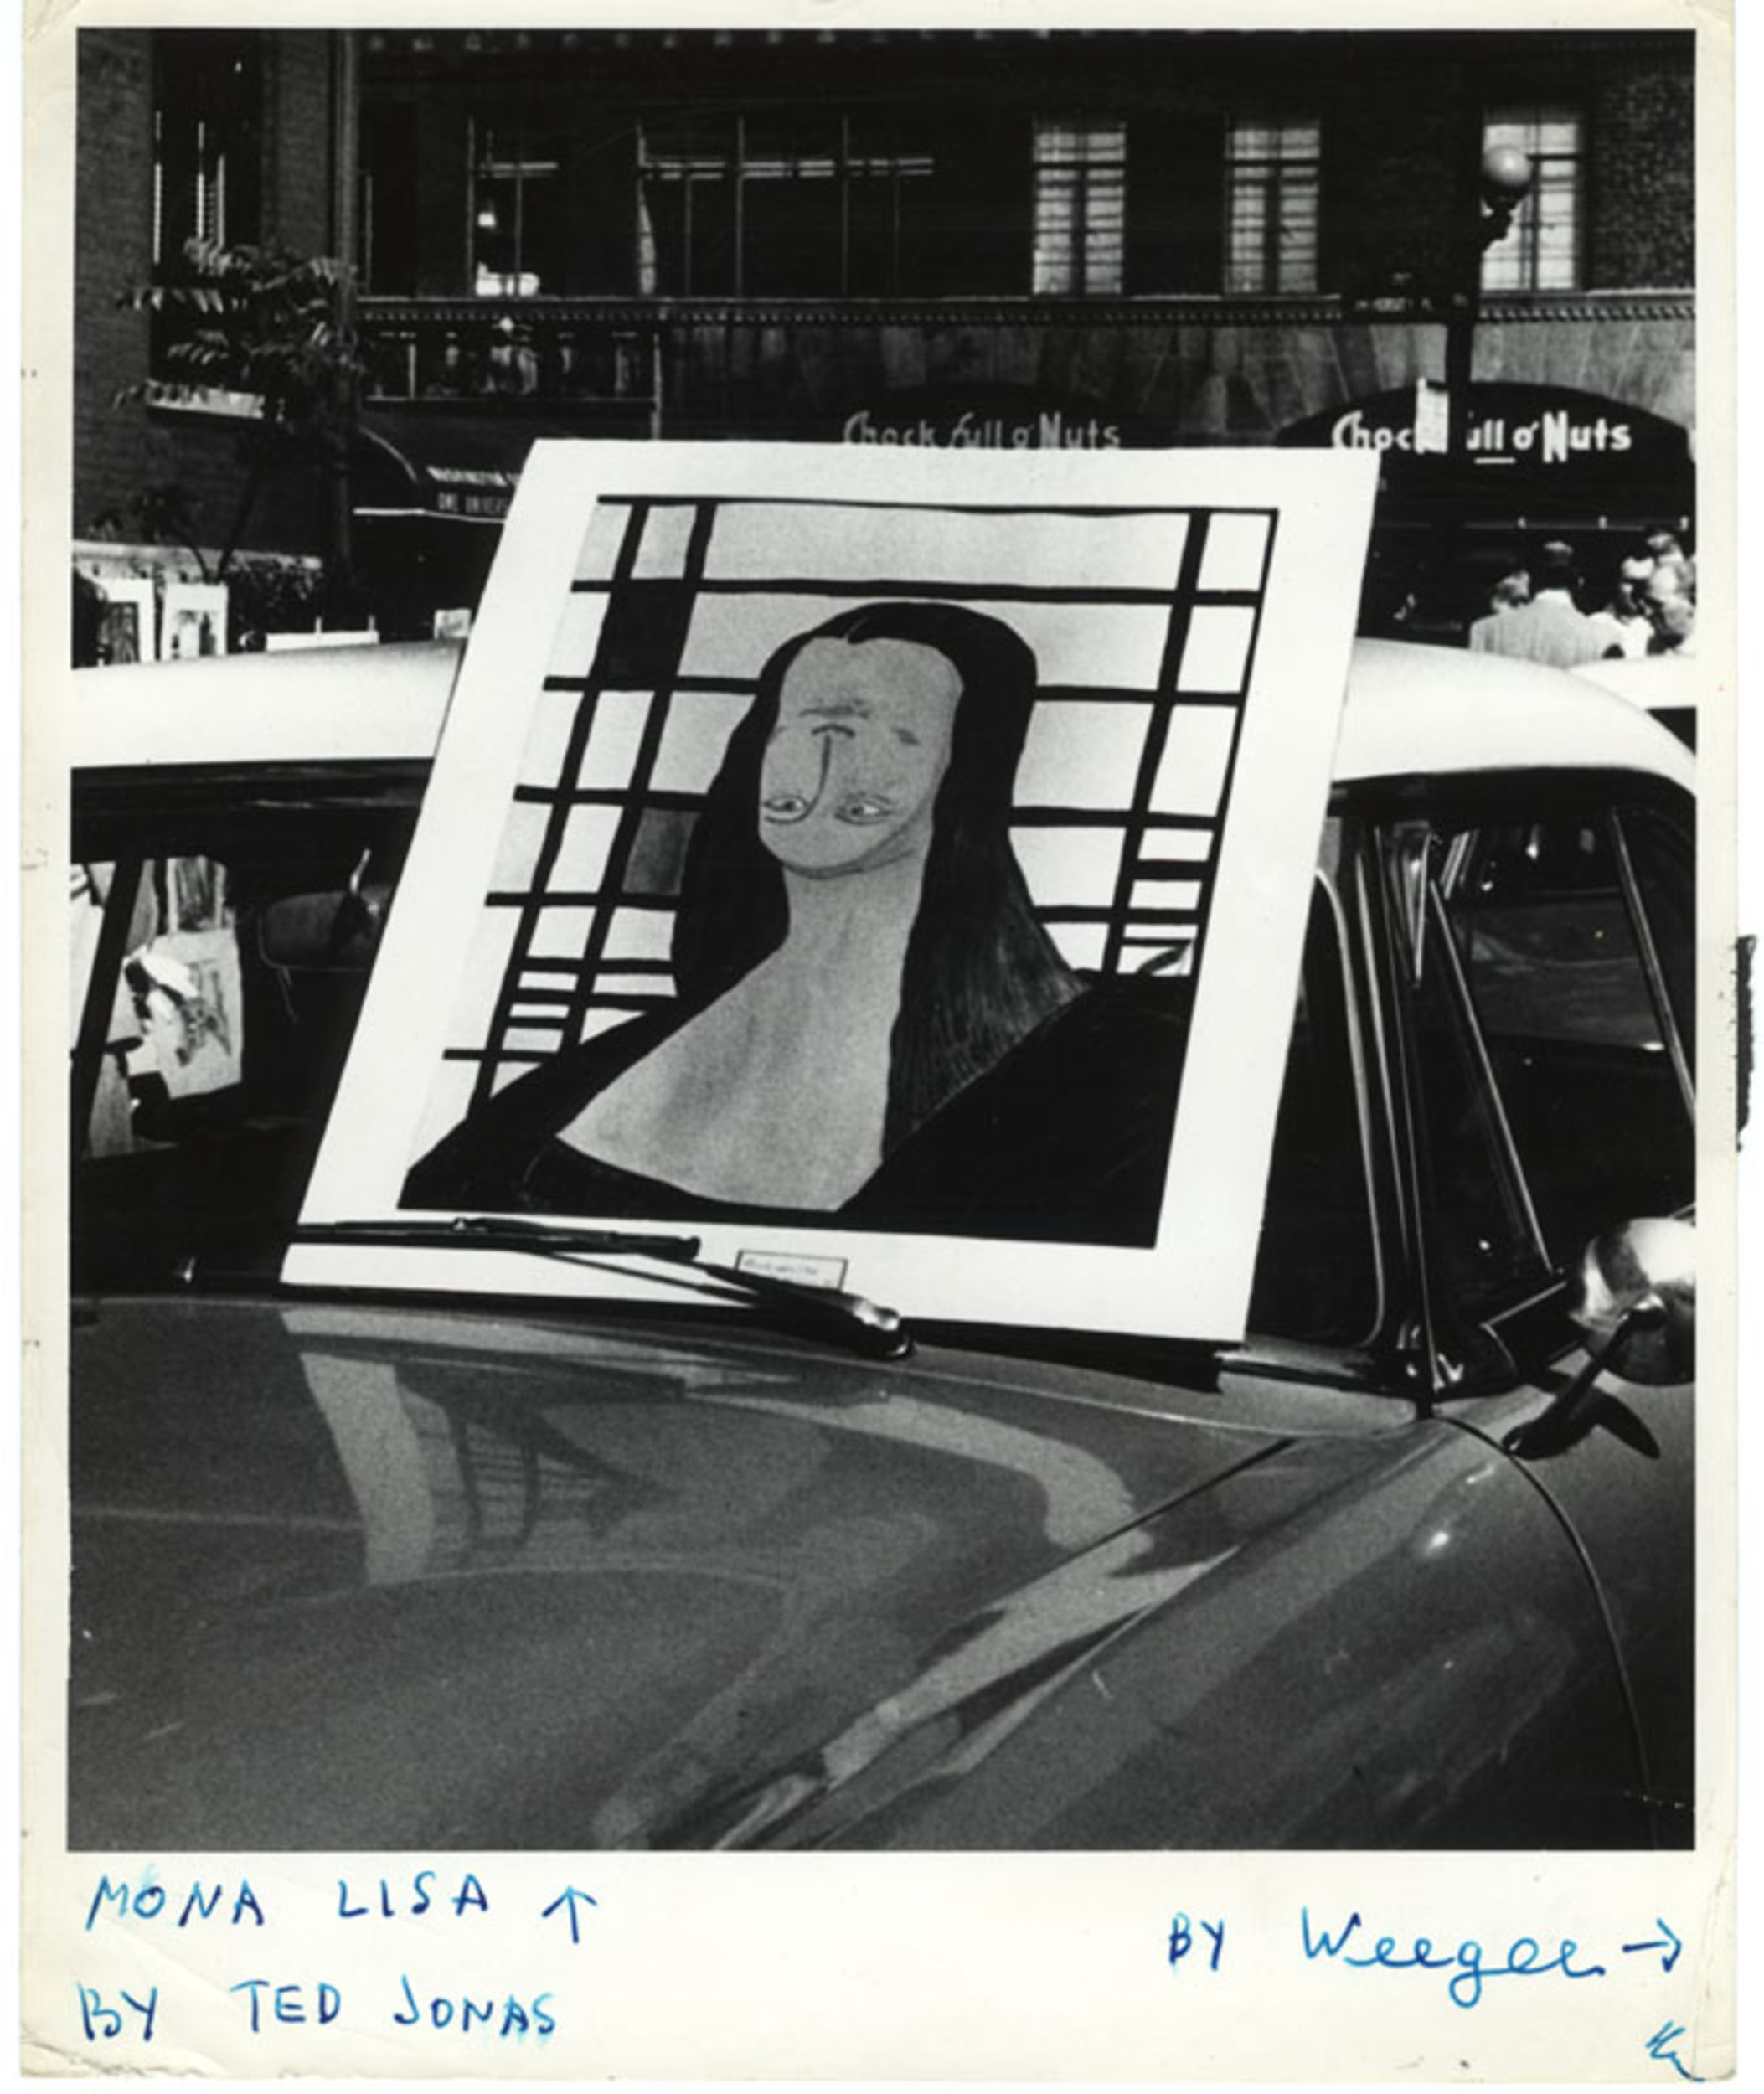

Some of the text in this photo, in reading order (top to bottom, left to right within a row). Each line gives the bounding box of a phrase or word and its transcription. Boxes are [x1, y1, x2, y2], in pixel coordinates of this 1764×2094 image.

[1332, 410, 1416, 451] Choc
[85, 1870, 488, 1930] MONA LISA
[1168, 1906, 1607, 2009] BY Weegee
[77, 1974, 557, 2041] BY TED JONAS
